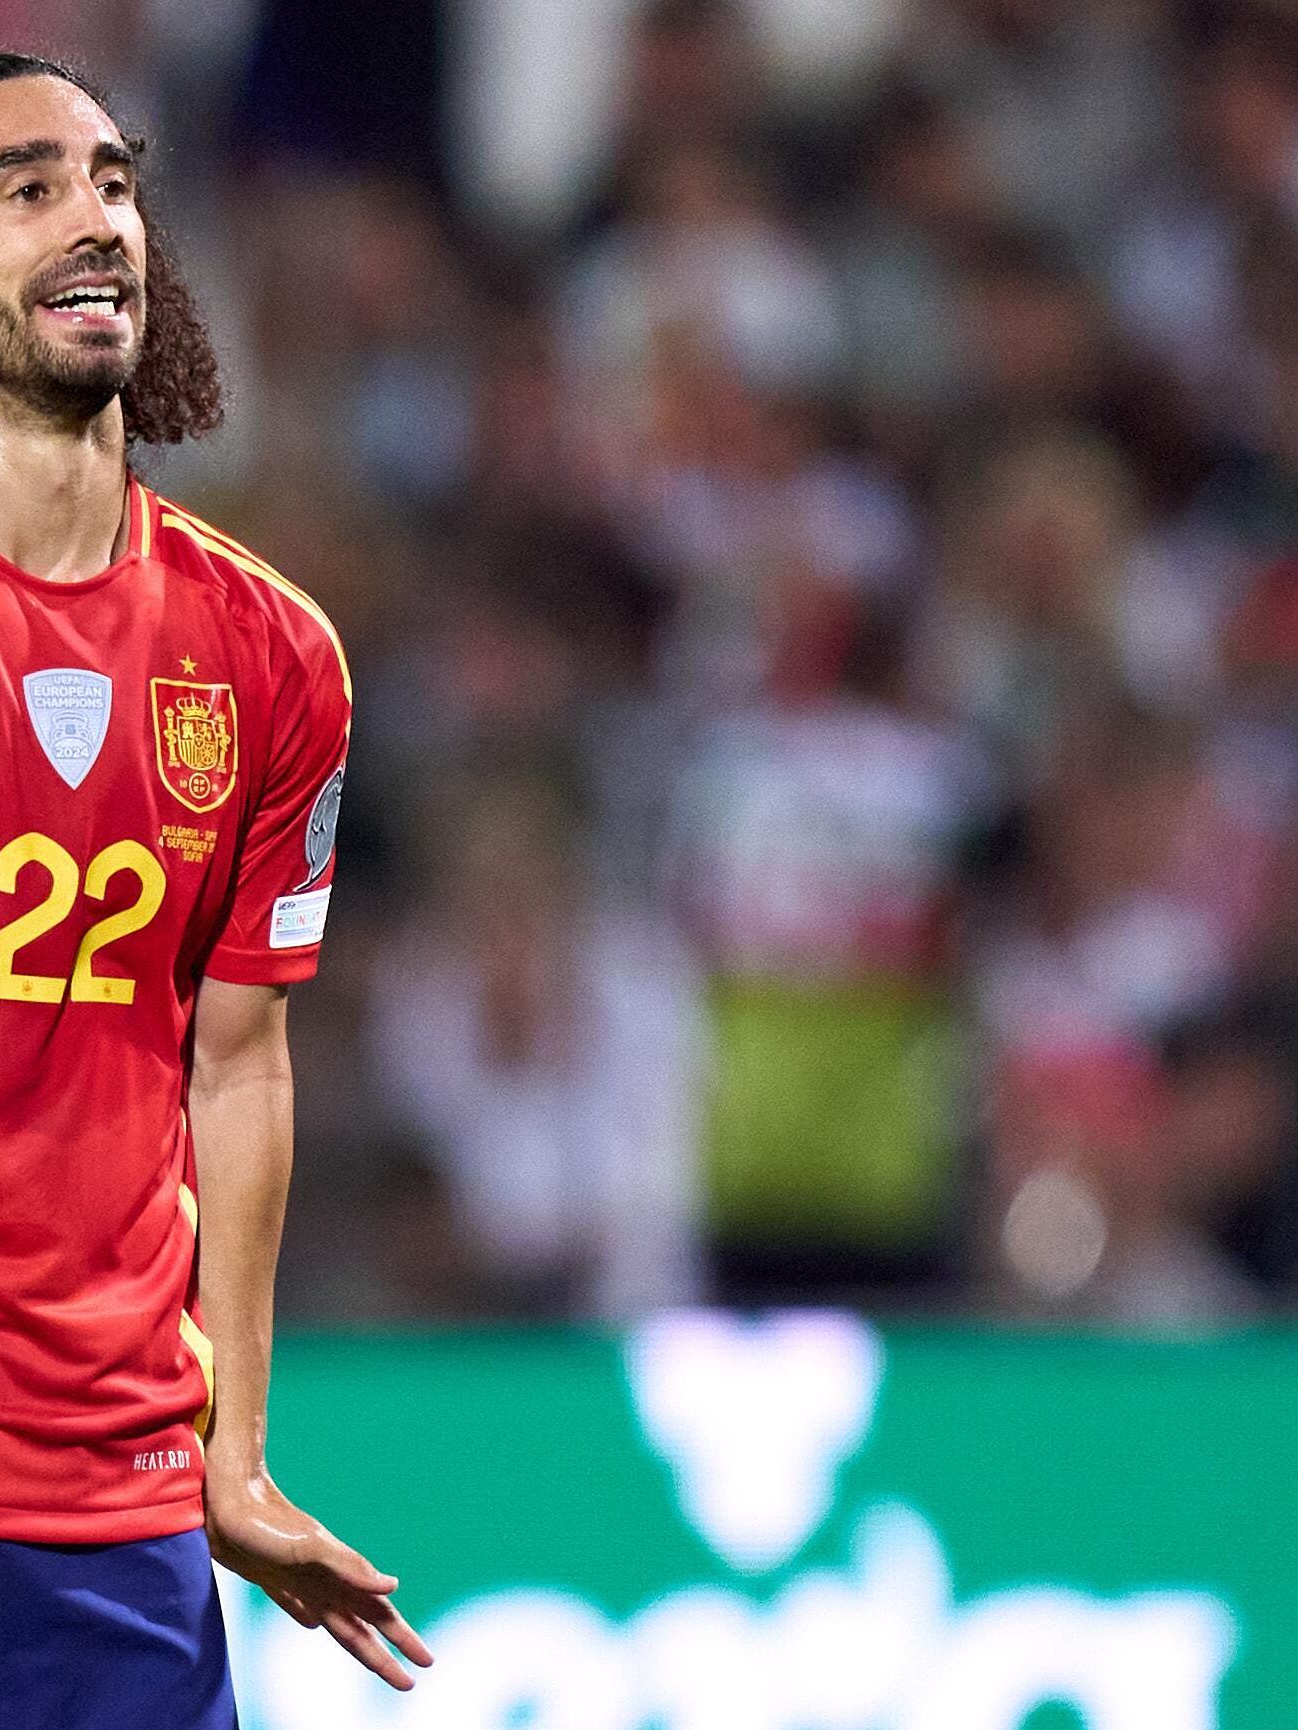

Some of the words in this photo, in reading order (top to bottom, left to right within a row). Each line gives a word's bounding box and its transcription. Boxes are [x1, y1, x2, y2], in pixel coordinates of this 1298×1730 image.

[33, 685, 103, 697] EUROPEAN
[34, 697, 105, 708] CHAMPIONS
[55, 746, 90, 759] 2024
